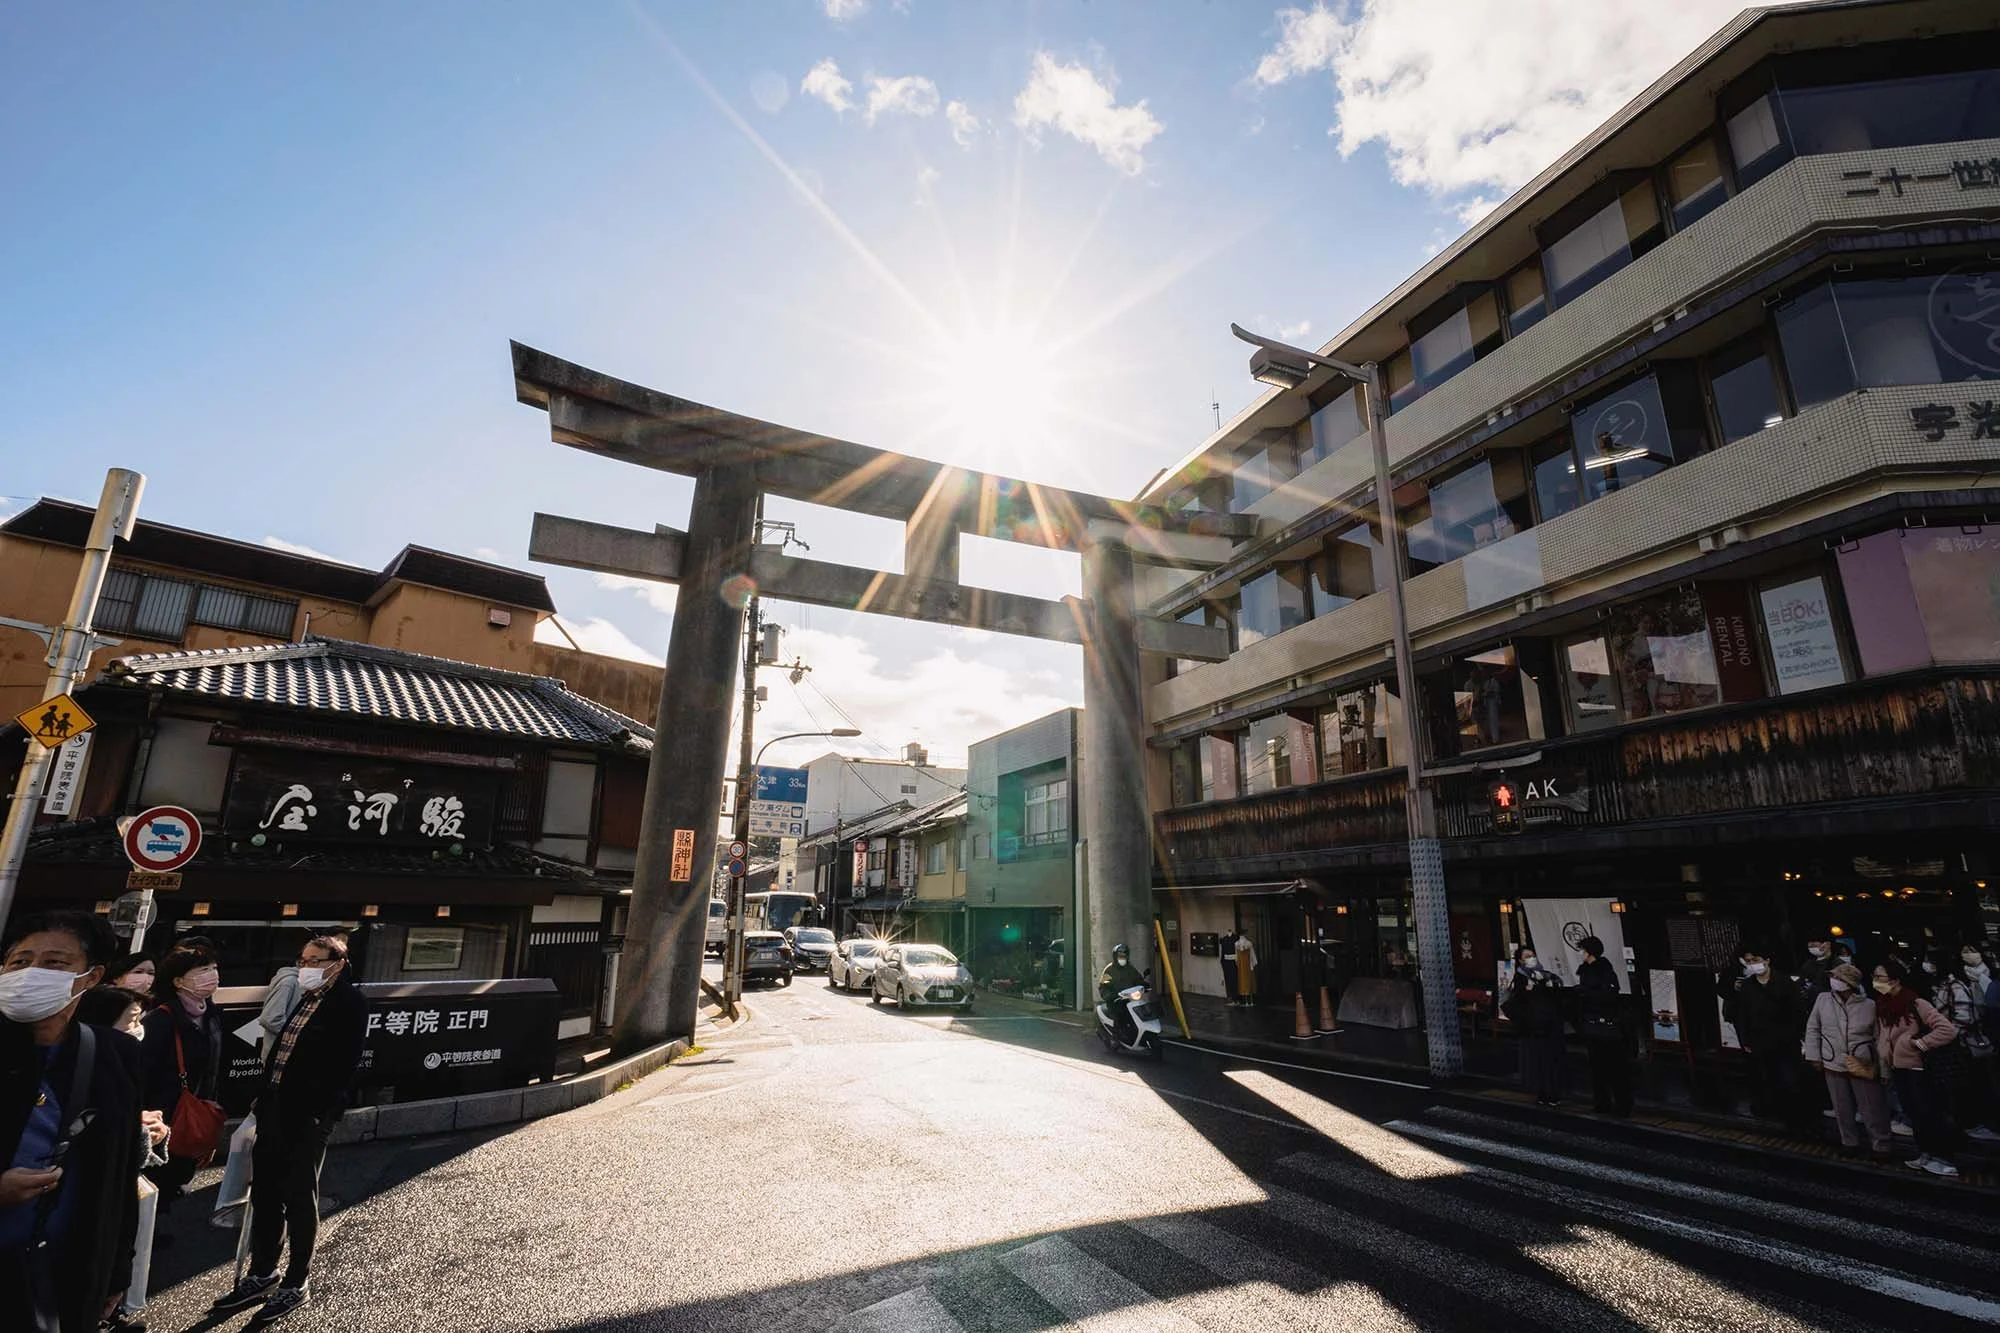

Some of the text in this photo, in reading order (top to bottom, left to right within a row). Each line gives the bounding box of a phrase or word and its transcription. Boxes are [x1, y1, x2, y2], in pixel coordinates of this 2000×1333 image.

[1714, 616, 1735, 667] RENTAL
[1730, 615, 1752, 666] KIMONO
[446, 1009, 489, 1030] 正門
[232, 1058, 256, 1066] World
[229, 1068, 264, 1079] Byodoi
